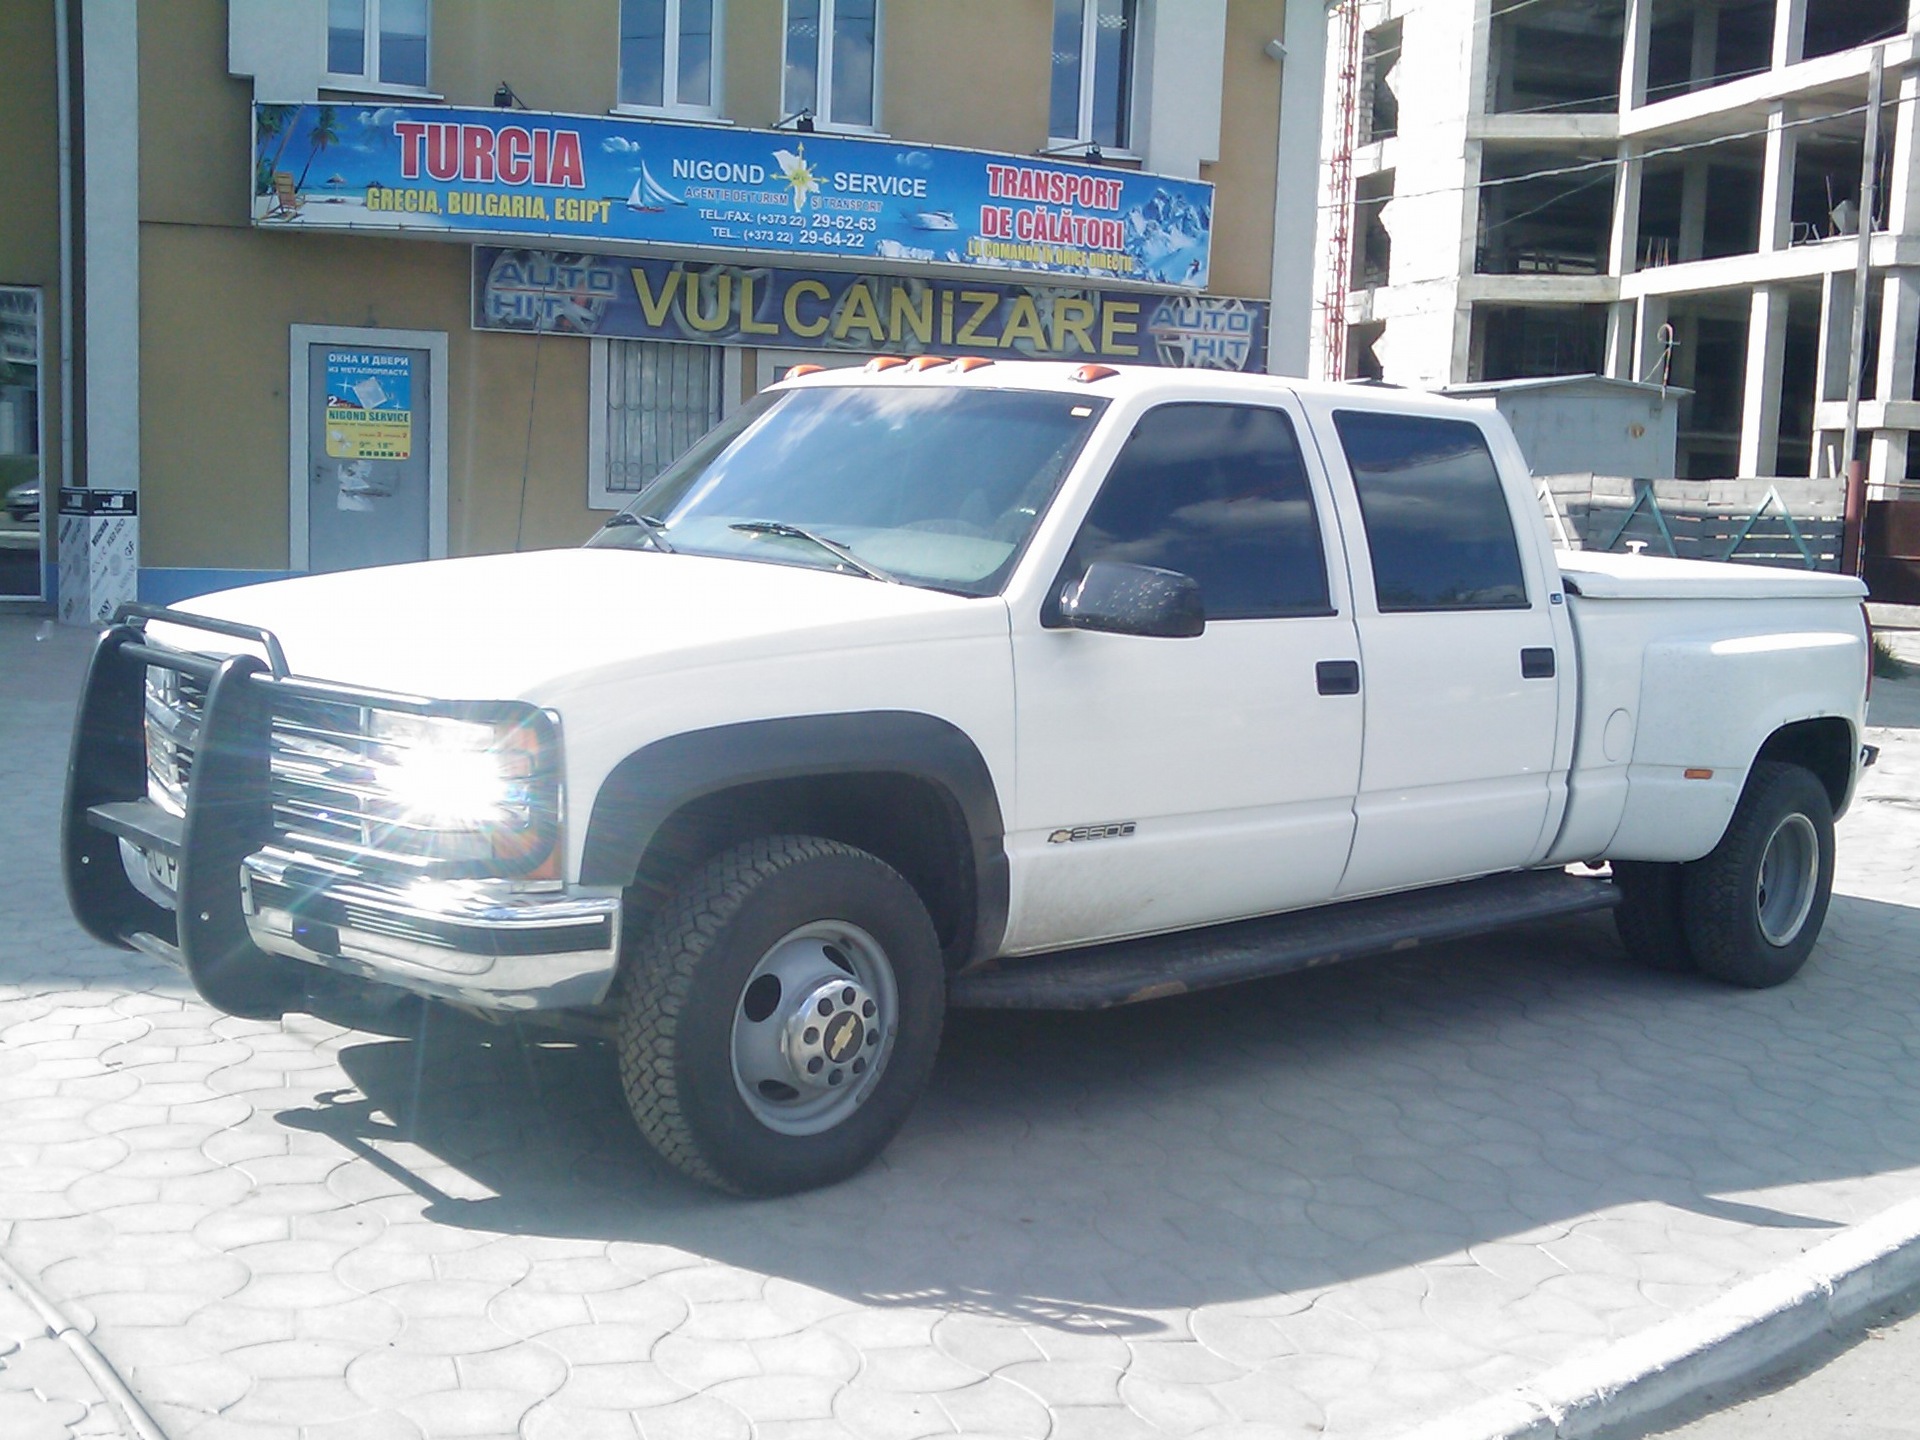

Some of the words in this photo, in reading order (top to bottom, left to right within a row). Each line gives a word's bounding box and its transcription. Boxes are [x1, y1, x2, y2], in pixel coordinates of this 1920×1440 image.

[394, 121, 585, 188] TURCIA
[672, 158, 765, 185] NIGOND
[833, 171, 927, 198] SERVICE
[987, 164, 1123, 211] TRANSPORT
[367, 187, 442, 215] GRECIA,
[448, 191, 549, 221] BULGARIA,
[554, 197, 611, 224] EGIPT
[732, 189, 748, 202] DE
[750, 191, 789, 206] TURISM
[823, 197, 883, 212] TRANSPORT
[757, 213, 787, 225] (+373
[789, 216, 807, 228] 22)
[812, 213, 877, 231] 29-62-63
[980, 205, 1012, 240] DE
[1016, 205, 1125, 251] CĂLĂTORI
[744, 229, 774, 242] (+373
[776, 232, 794, 245] 22)
[799, 229, 865, 248] 29-64-22
[968, 239, 981, 257] LA
[1056, 248, 1087, 267] ORICE
[494, 262, 614, 291] AUTO
[493, 293, 563, 319] HIT
[631, 268, 1139, 356] VULCANIZARE
[1151, 307, 1249, 331] AUTO
[328, 353, 358, 363] ОКНА
[361, 355, 369, 364] И
[372, 356, 408, 366] ДВЕРИ
[1192, 338, 1249, 359] HIT
[328, 395, 338, 407] 2
[368, 411, 409, 423] SERVICE
[1072, 822, 1137, 842] 3500
